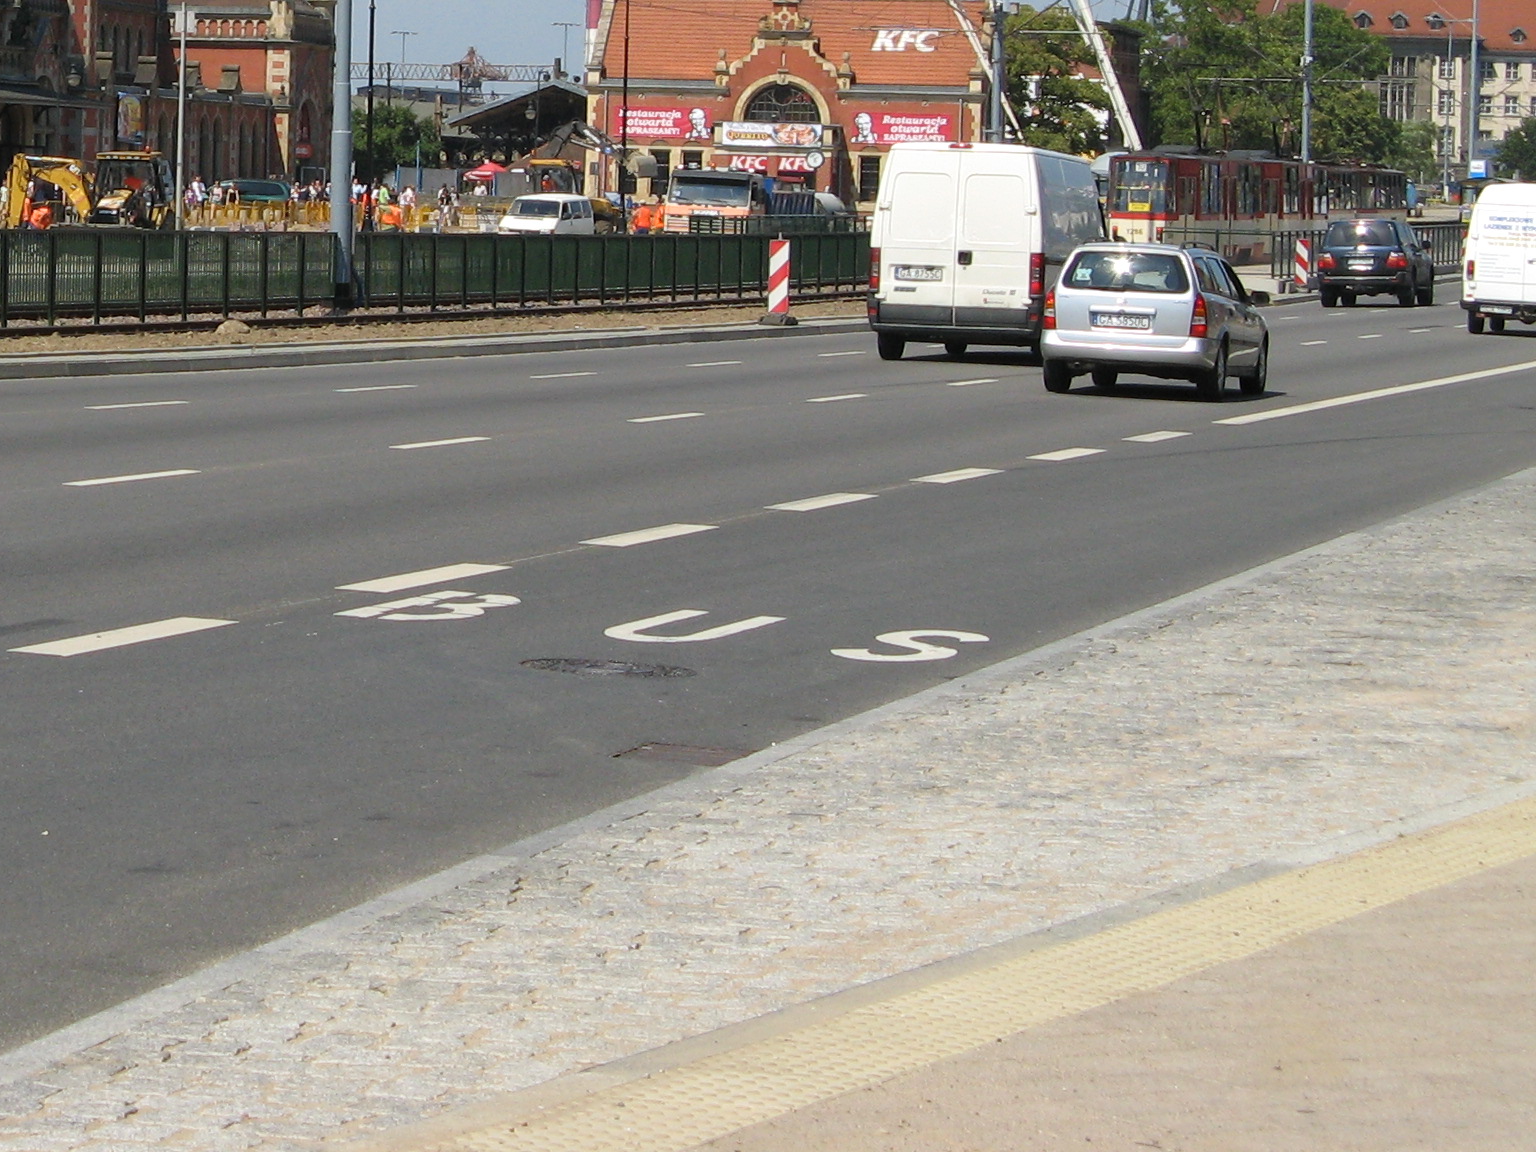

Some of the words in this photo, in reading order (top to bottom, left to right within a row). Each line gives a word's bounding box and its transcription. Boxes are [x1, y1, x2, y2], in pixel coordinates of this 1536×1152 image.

[871, 30, 939, 52] KFC
[626, 117, 674, 126] otwarta
[882, 115, 947, 125] Restauracja
[890, 125, 939, 134] otwarta
[730, 156, 768, 170] KFC
[333, 590, 990, 663] BUS
